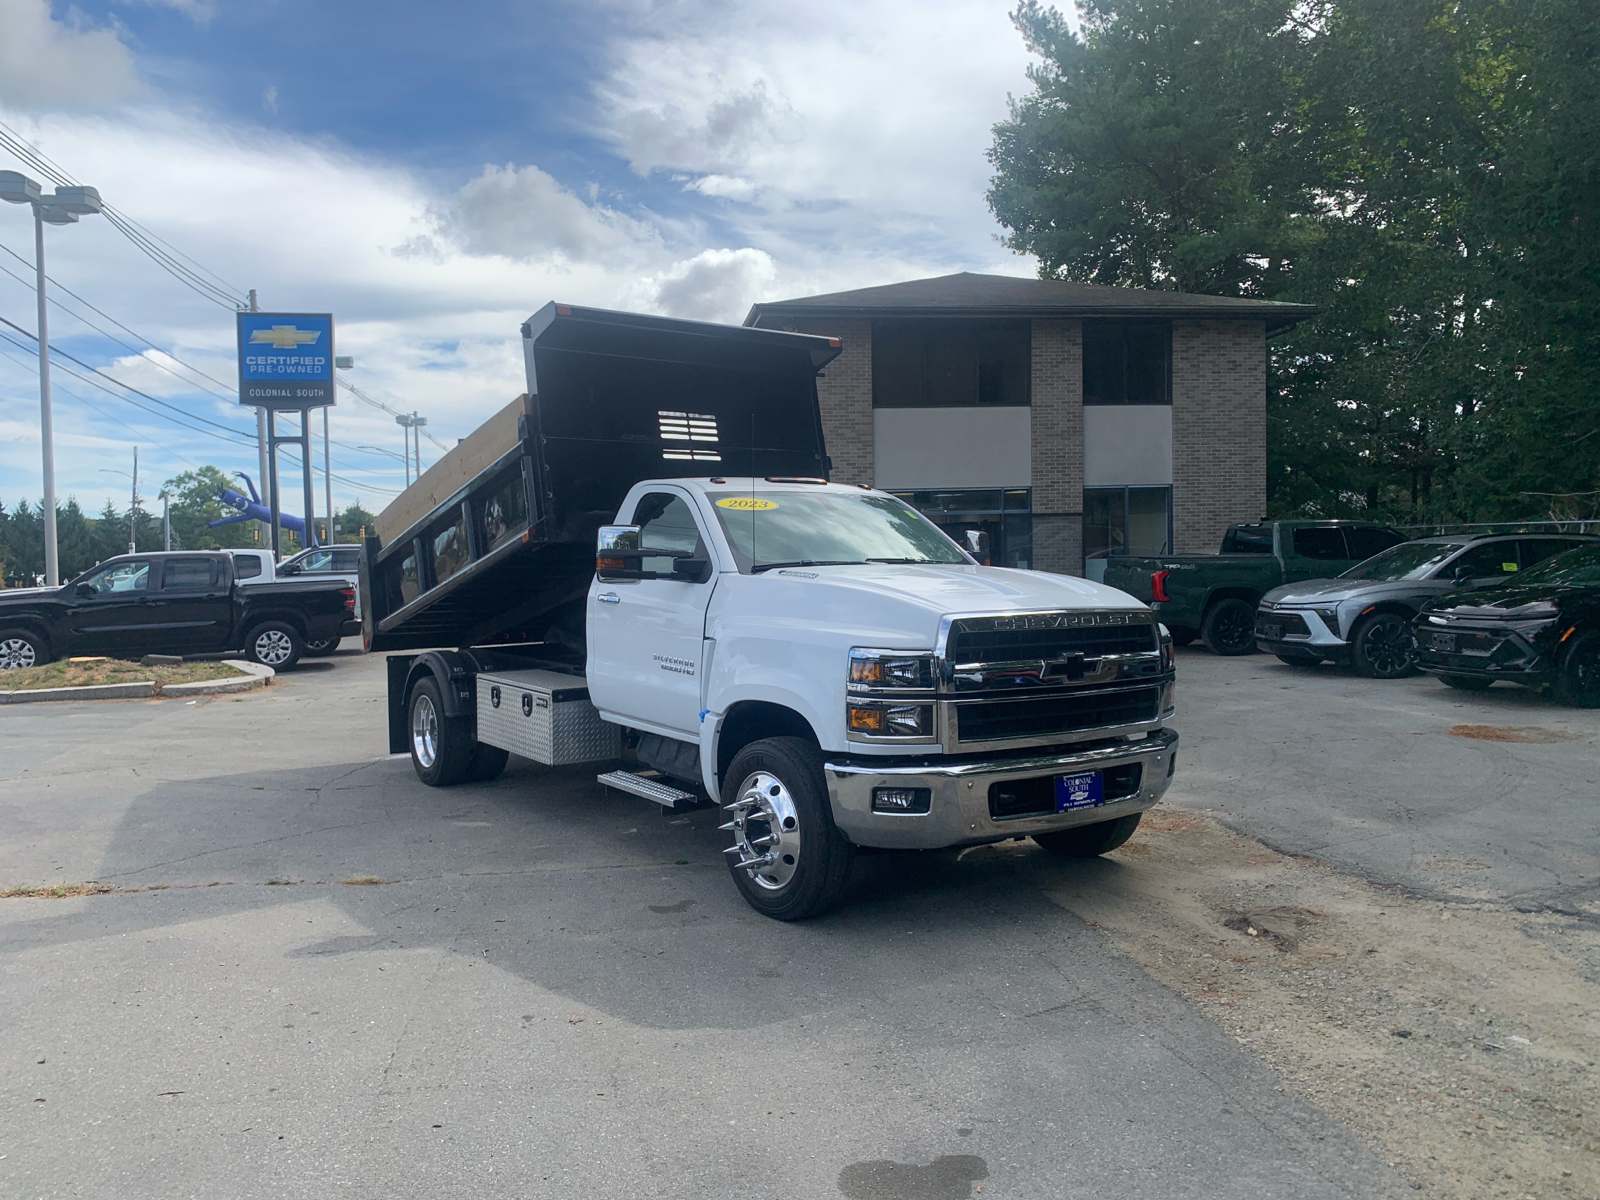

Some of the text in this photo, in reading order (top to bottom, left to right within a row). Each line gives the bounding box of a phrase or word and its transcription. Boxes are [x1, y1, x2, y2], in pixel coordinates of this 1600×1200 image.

[246, 356, 325, 365] CERTIFIED
[250, 365, 322, 374] PRE-OWNED
[249, 388, 324, 397] COLONIAL SOUTH
[728, 500, 768, 508] 2023
[993, 613, 1133, 630] CHEVROLET
[1063, 777, 1093, 788] COLONIAL
[1068, 784, 1089, 793] SOUTH
